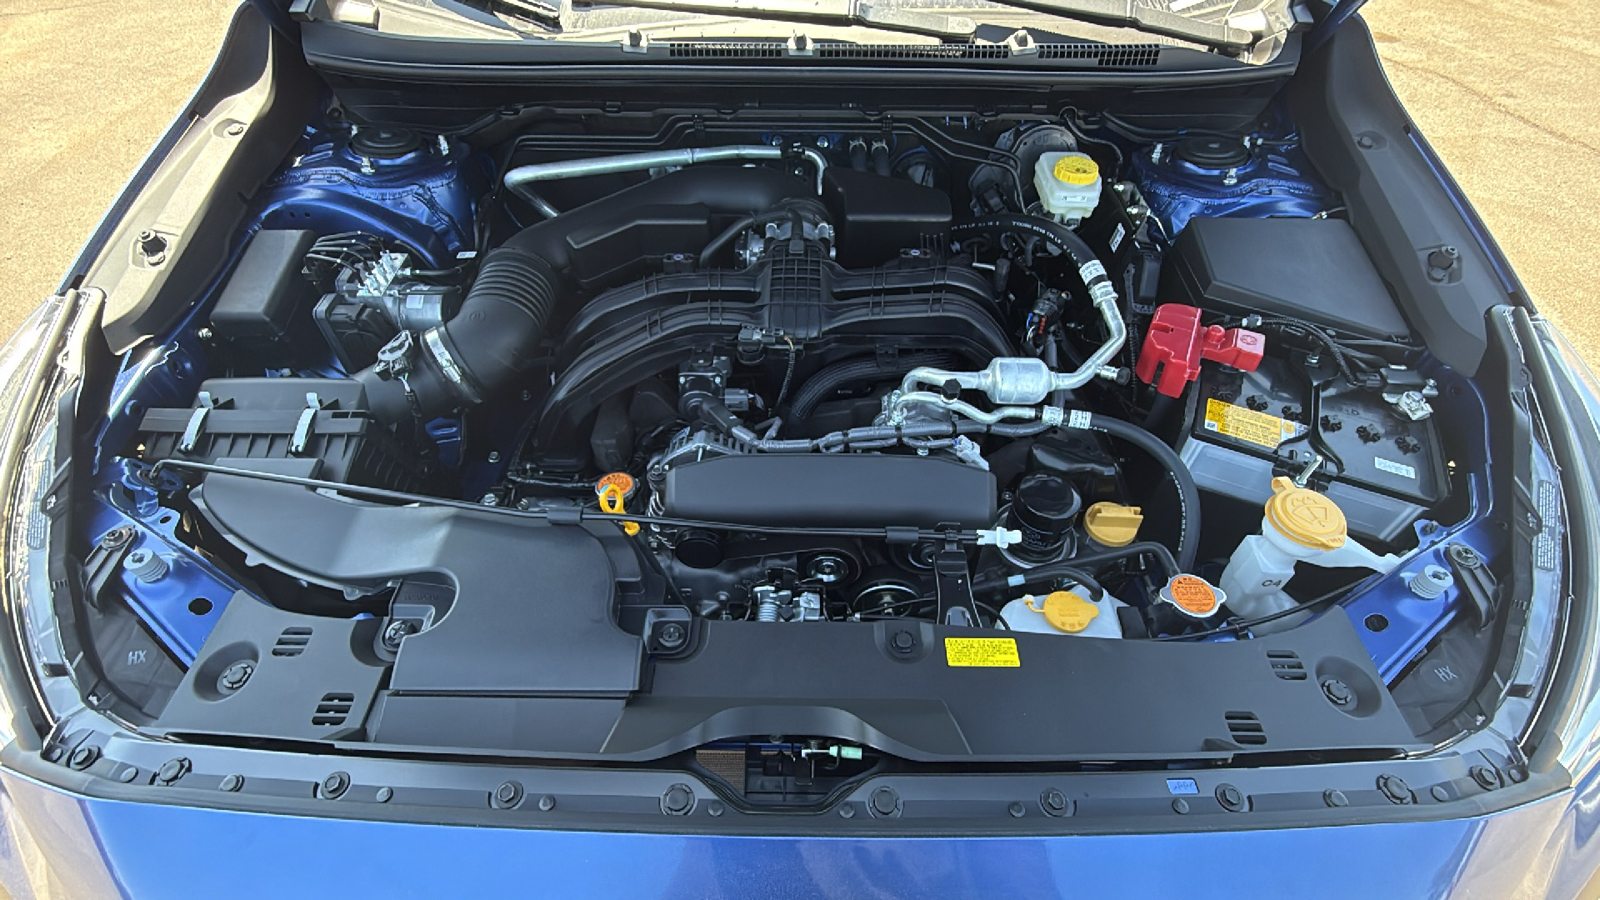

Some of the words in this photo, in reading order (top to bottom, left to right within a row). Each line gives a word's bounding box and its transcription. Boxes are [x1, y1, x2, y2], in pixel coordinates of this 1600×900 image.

[1261, 579, 1282, 587] C4
[127, 649, 147, 666] HX
[1433, 665, 1459, 682] HX
